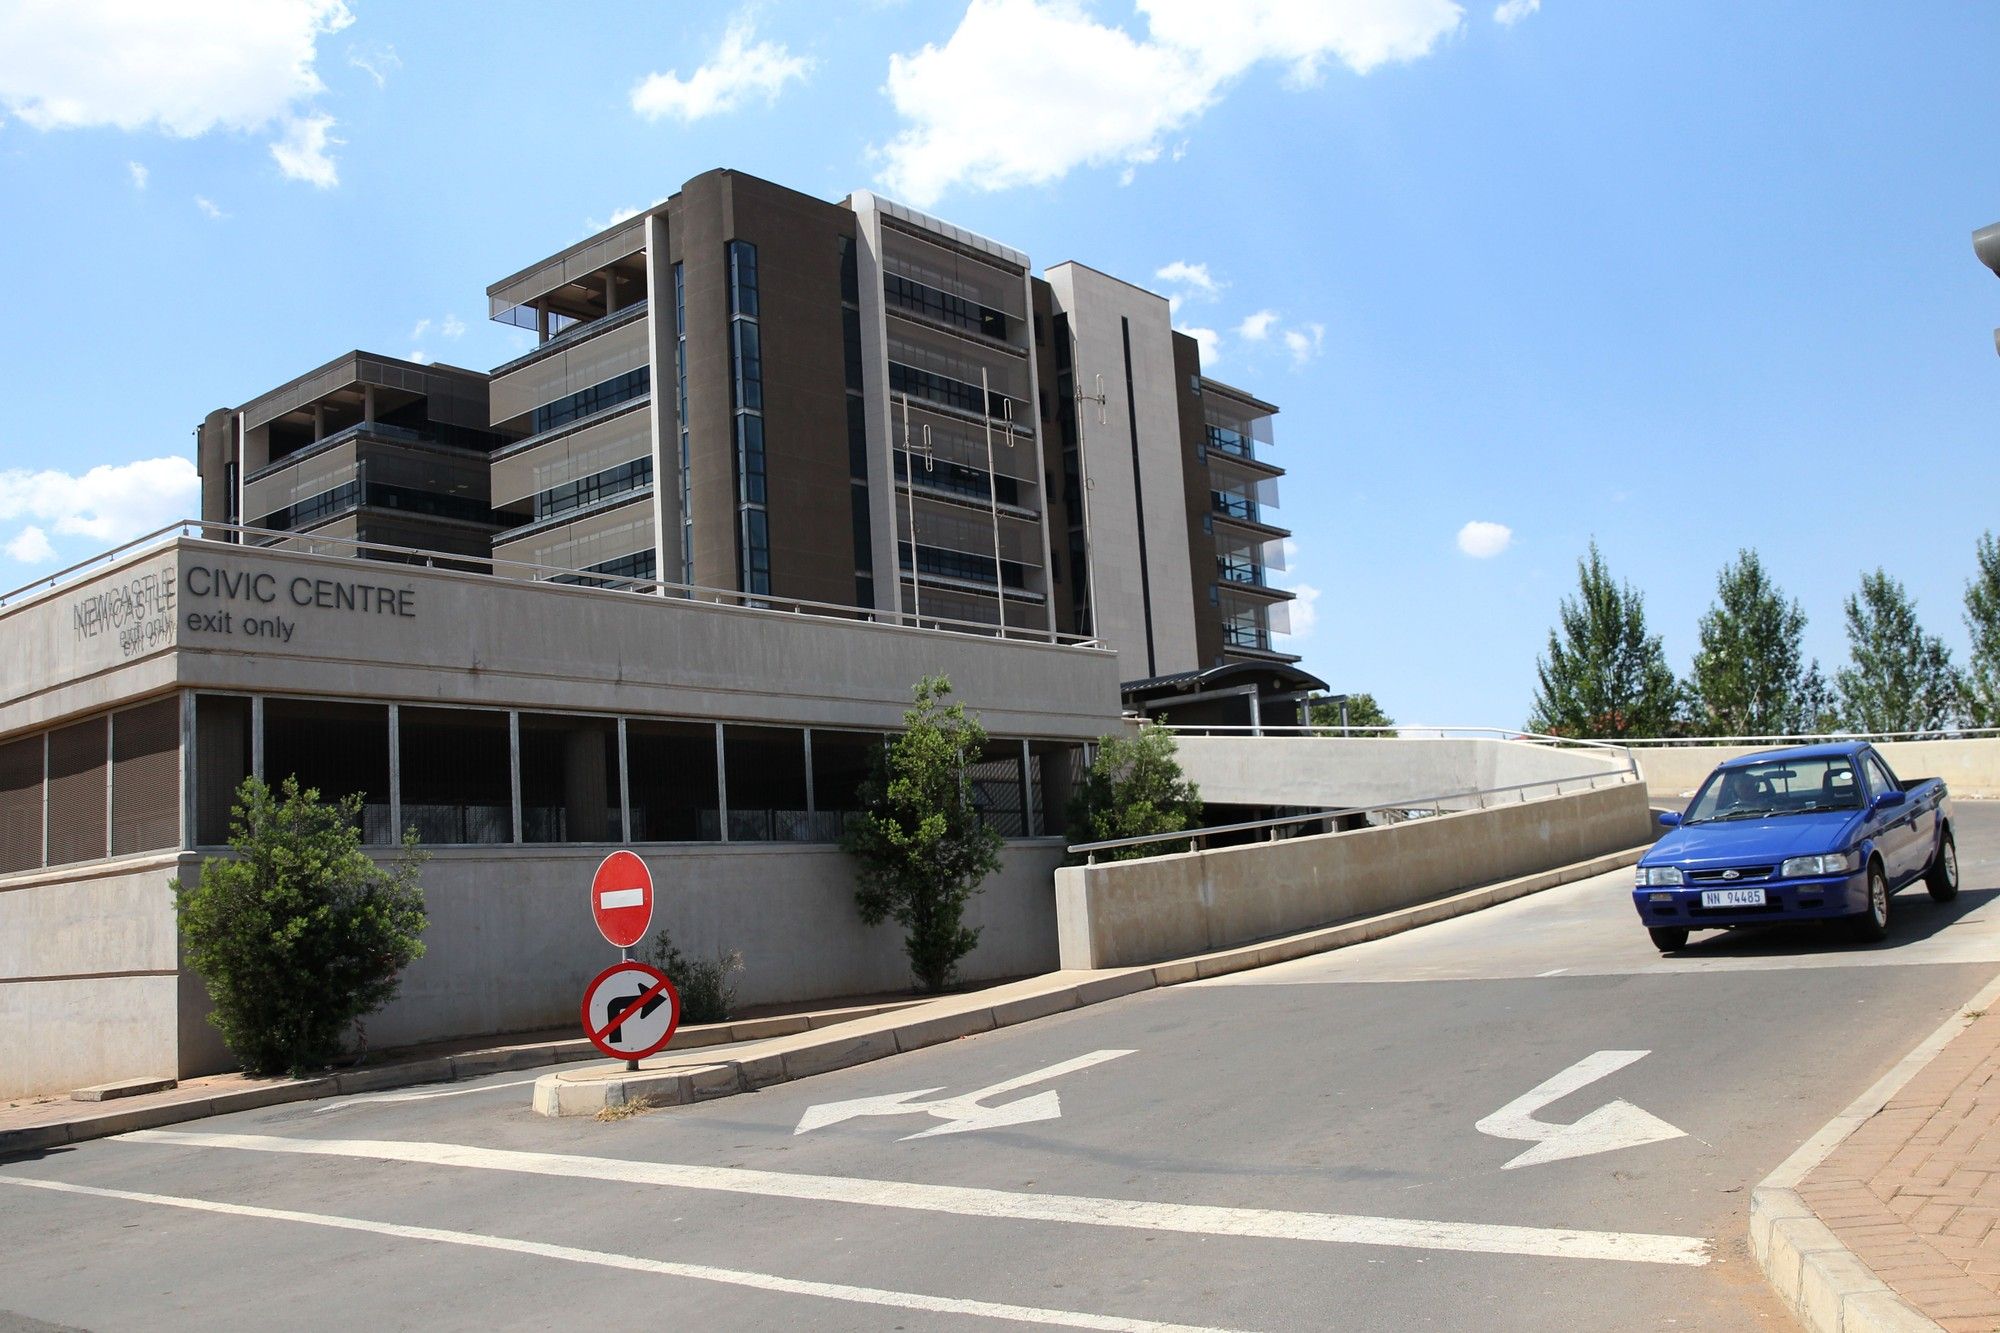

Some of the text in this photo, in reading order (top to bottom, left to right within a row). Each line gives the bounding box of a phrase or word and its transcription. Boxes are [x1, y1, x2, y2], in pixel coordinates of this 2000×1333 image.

[74, 567, 176, 637] NEWCASTLE
[187, 566, 416, 618] CIVIC CENTRE
[120, 621, 143, 654] exit
[187, 610, 295, 643] exit only
[1707, 890, 1761, 905] NN 94485
